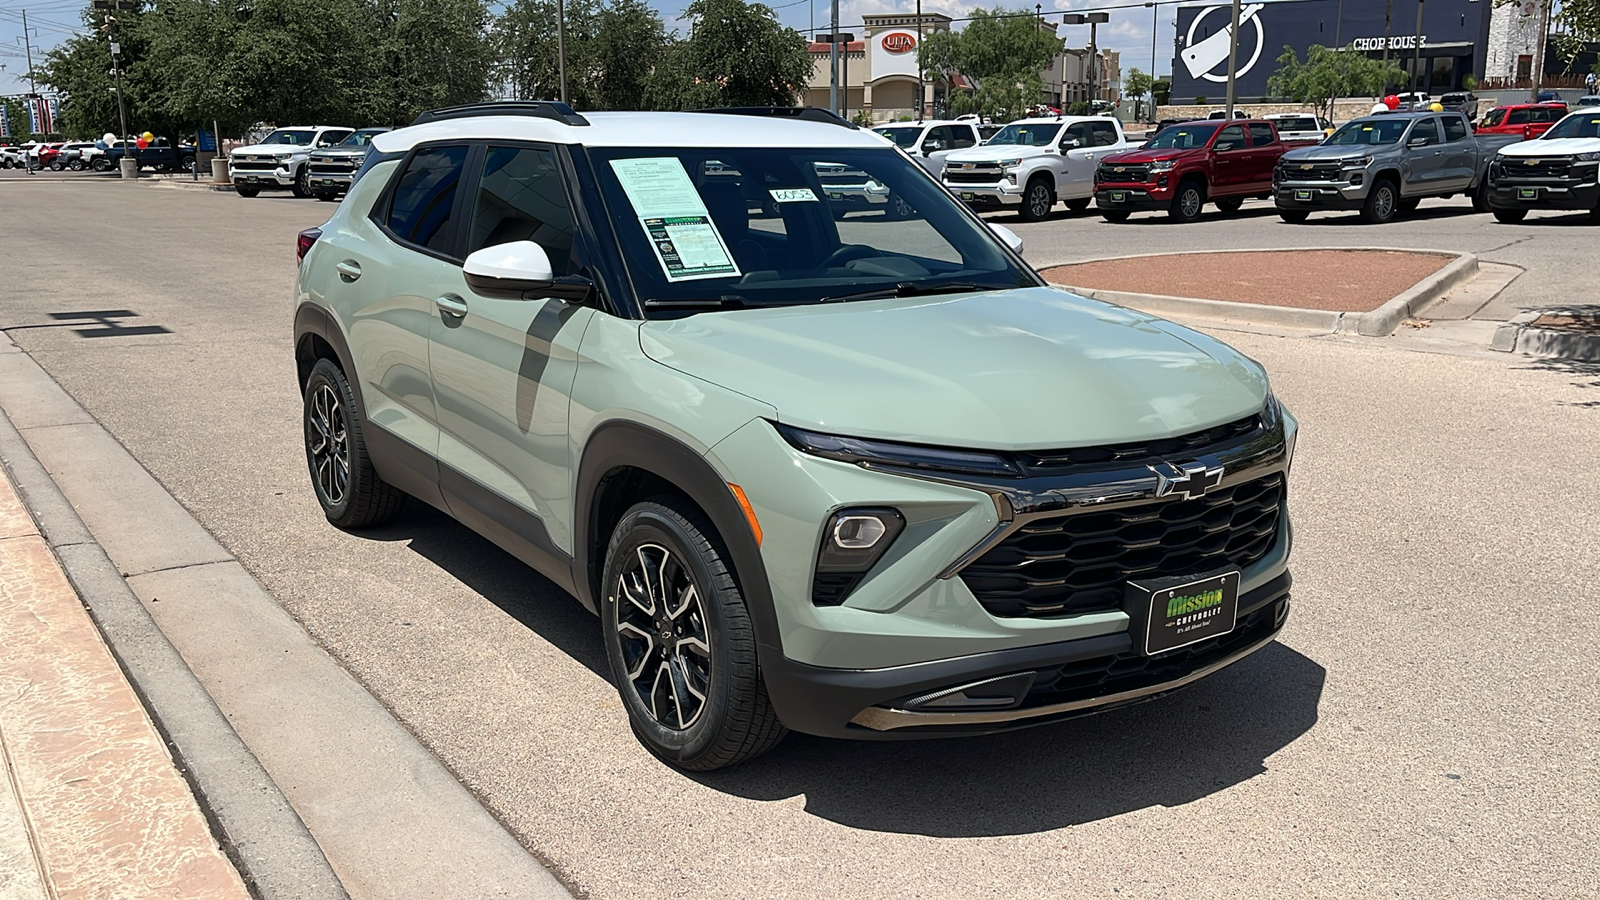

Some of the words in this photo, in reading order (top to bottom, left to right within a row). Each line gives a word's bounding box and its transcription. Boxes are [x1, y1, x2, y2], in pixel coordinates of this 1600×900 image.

[886, 36, 912, 46] ULTA
[1353, 35, 1426, 51] CHOPHOUSE
[775, 190, 814, 200] 6053
[1176, 606, 1221, 626] CHEVROLET
